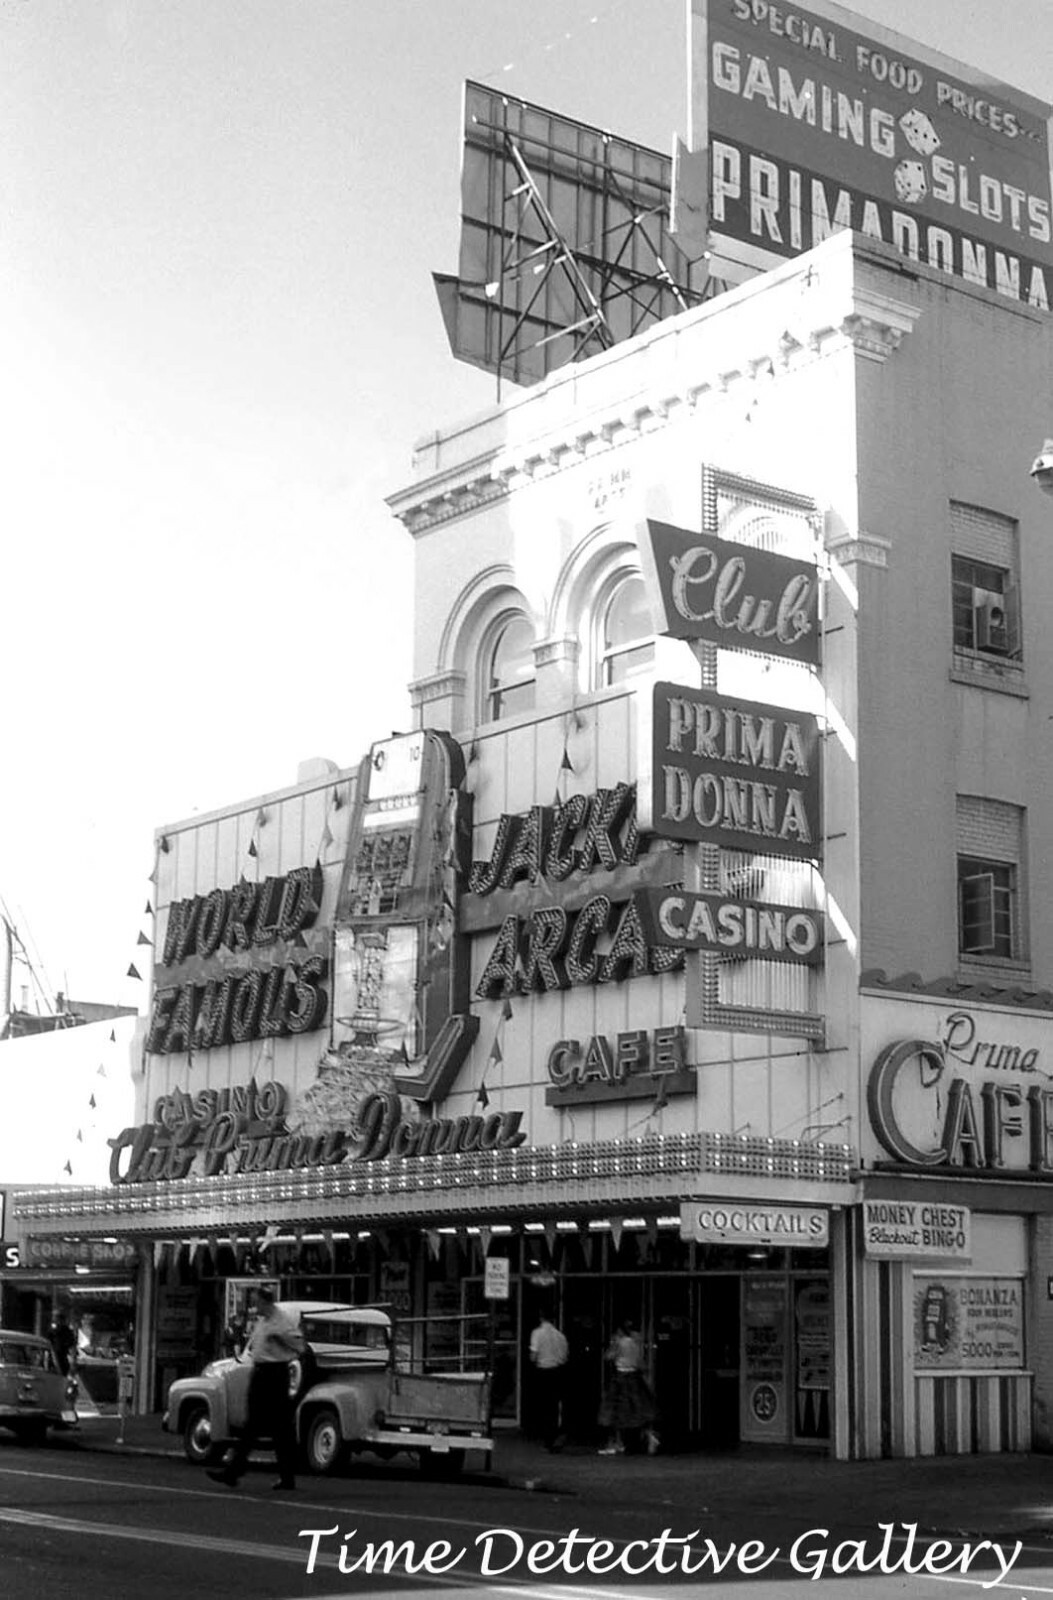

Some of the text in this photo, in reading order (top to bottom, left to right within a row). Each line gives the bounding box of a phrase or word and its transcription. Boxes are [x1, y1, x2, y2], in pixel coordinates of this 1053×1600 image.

[712, 41, 896, 158] GAMING
[857, 45, 923, 94] FOOD
[932, 155, 1051, 243] SLOTS
[669, 547, 812, 645] Club
[666, 697, 809, 777] PRIMA
[661, 764, 811, 844] DONNA
[163, 866, 324, 967] WORLD
[659, 896, 817, 955] CASINO
[147, 954, 328, 1054] FAMOUS
[547, 1026, 685, 1088] CAFE
[944, 1011, 1040, 1073] Prima
[355, 1090, 528, 1164] Donna
[699, 1211, 825, 1235] COCKTAILS
[867, 1205, 965, 1229] MONEY CHEST
[922, 1229, 966, 1248] BINGO
[959, 1288, 1018, 1306] BONANZA
